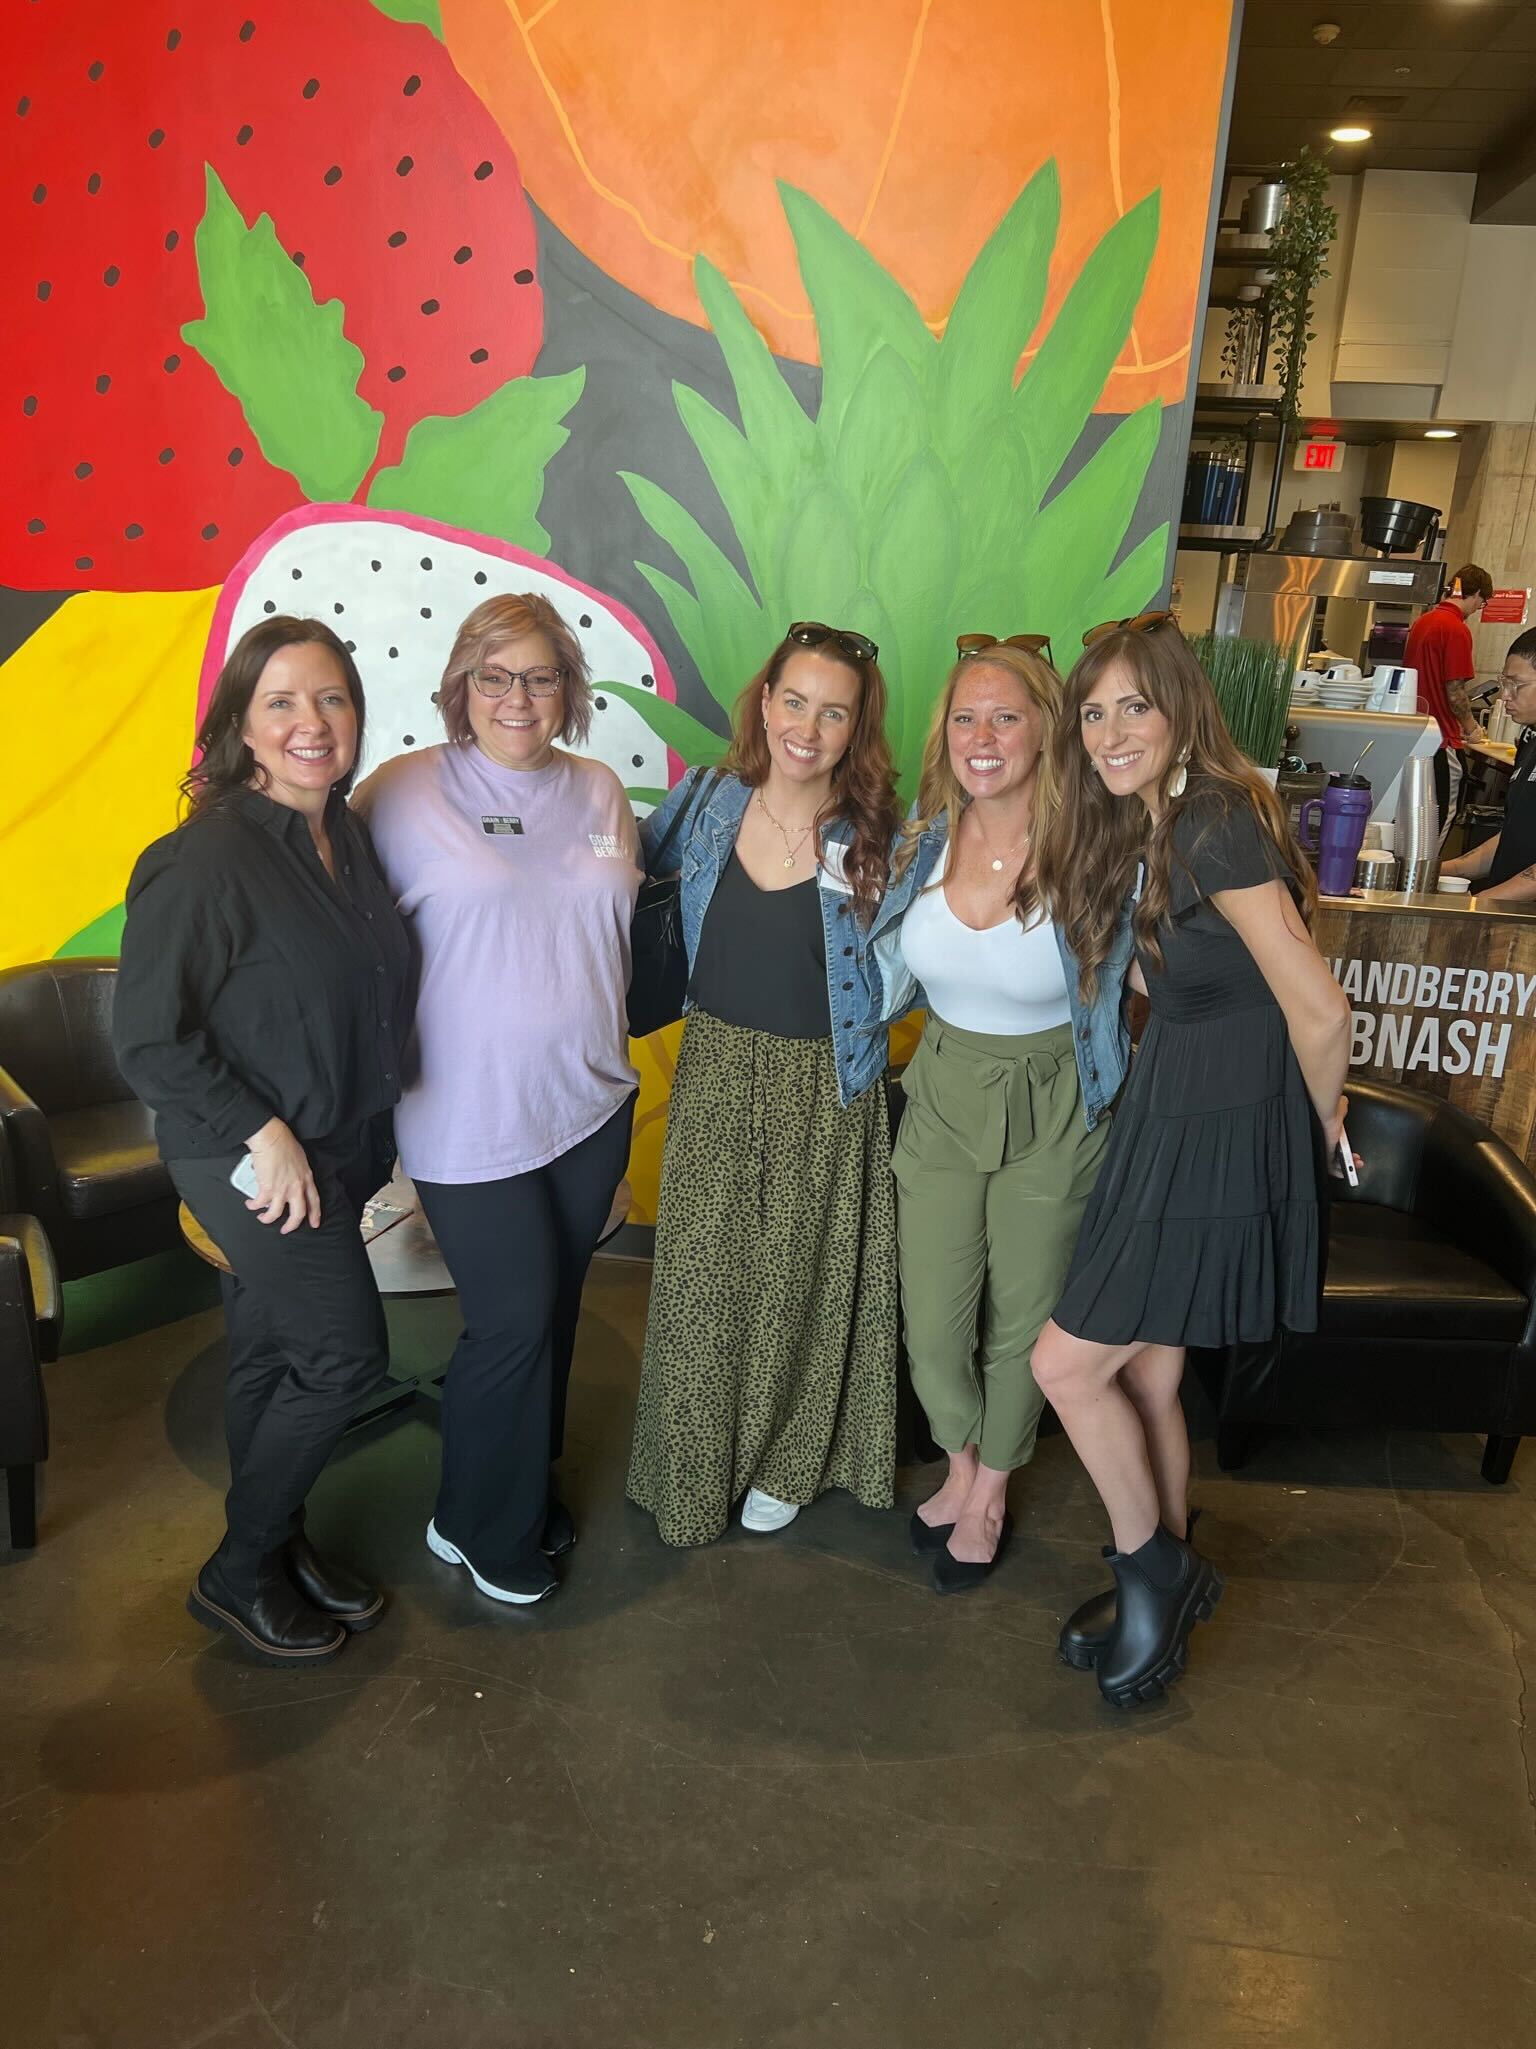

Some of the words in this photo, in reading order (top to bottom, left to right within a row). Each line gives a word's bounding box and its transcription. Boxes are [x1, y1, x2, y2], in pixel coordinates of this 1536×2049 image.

[1304, 444, 1337, 469] EXIT
[1324, 957, 1536, 1018] ANDBERRY
[1349, 1010, 1513, 1078] BNASH
